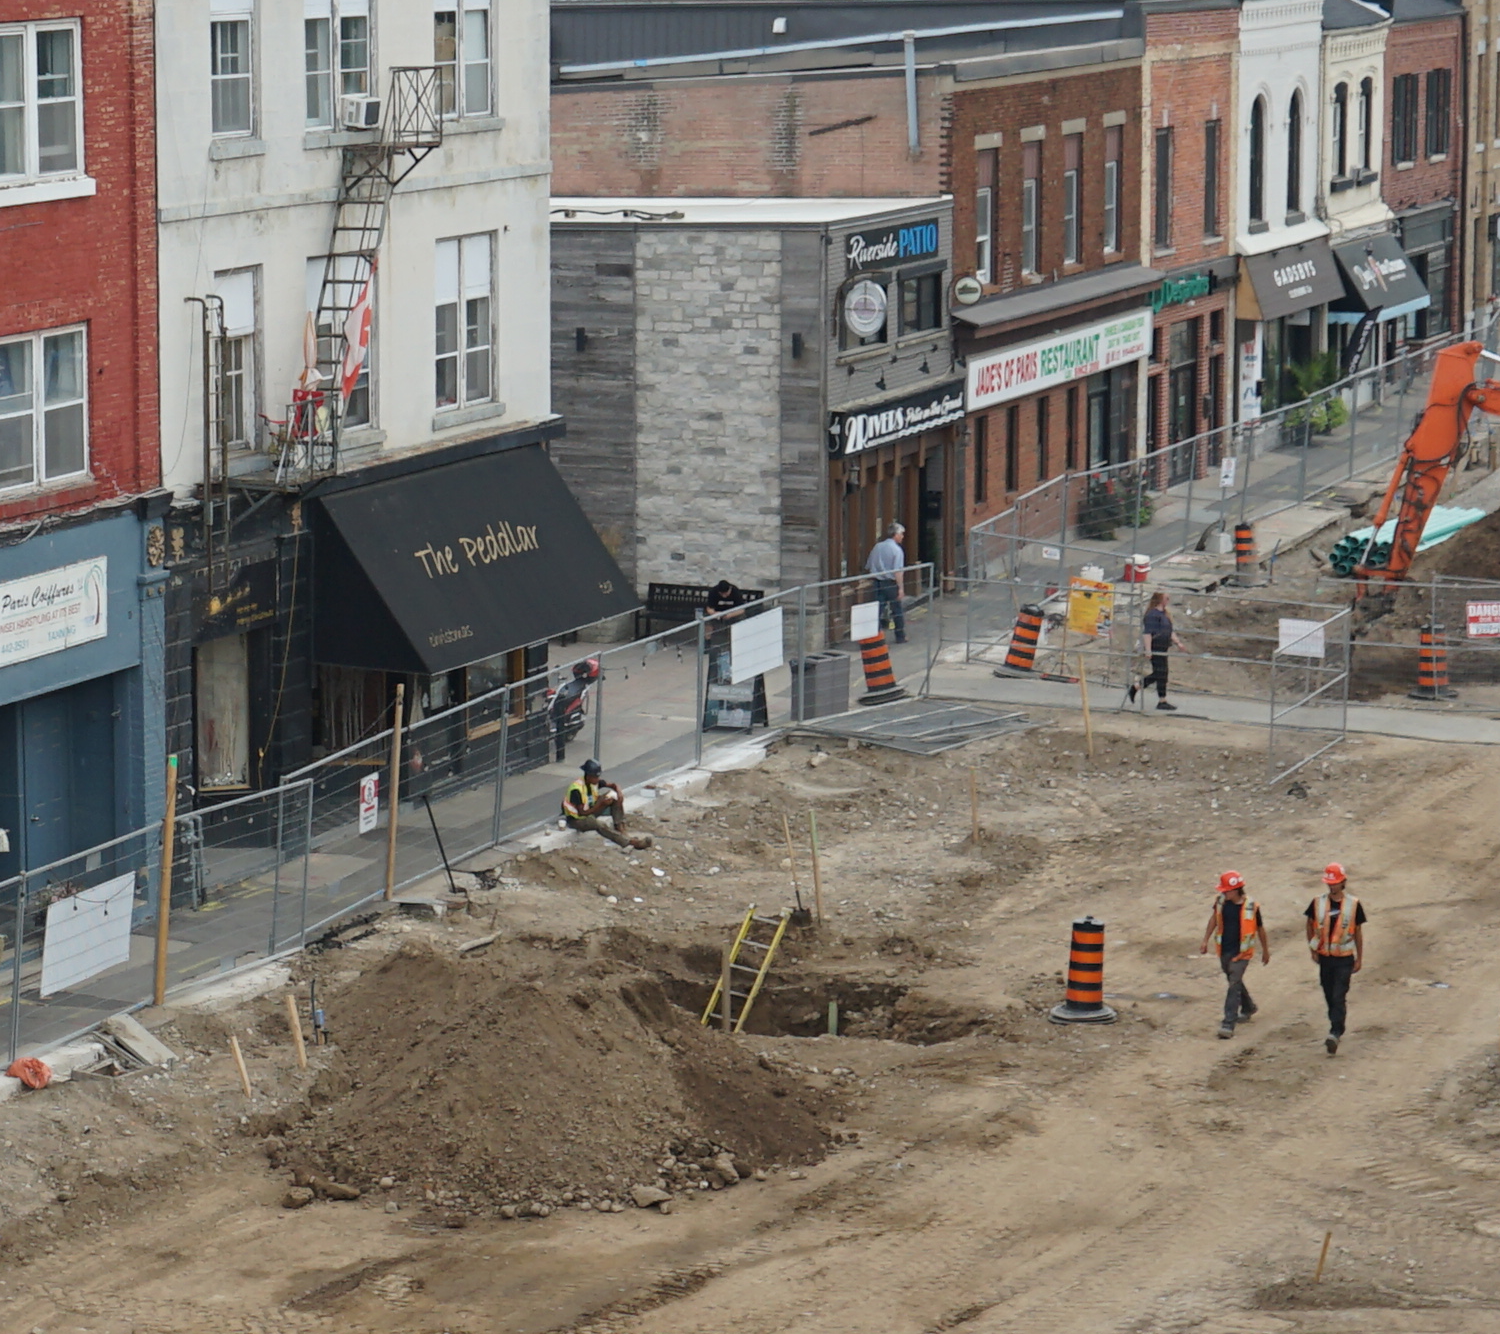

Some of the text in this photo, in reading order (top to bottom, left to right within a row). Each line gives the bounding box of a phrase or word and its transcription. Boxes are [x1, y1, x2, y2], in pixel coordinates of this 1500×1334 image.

[847, 223, 937, 270] Riverside PATIO
[975, 362, 1003, 397] JADE'S
[1004, 359, 1015, 389] OF
[1016, 351, 1038, 385] PARIS
[1040, 333, 1100, 378] RESTAURANT
[414, 521, 540, 579] The Peddlar
[1, 594, 30, 614] Paris
[31, 583, 75, 608] Coiffures
[68, 602, 82, 616] BEST
